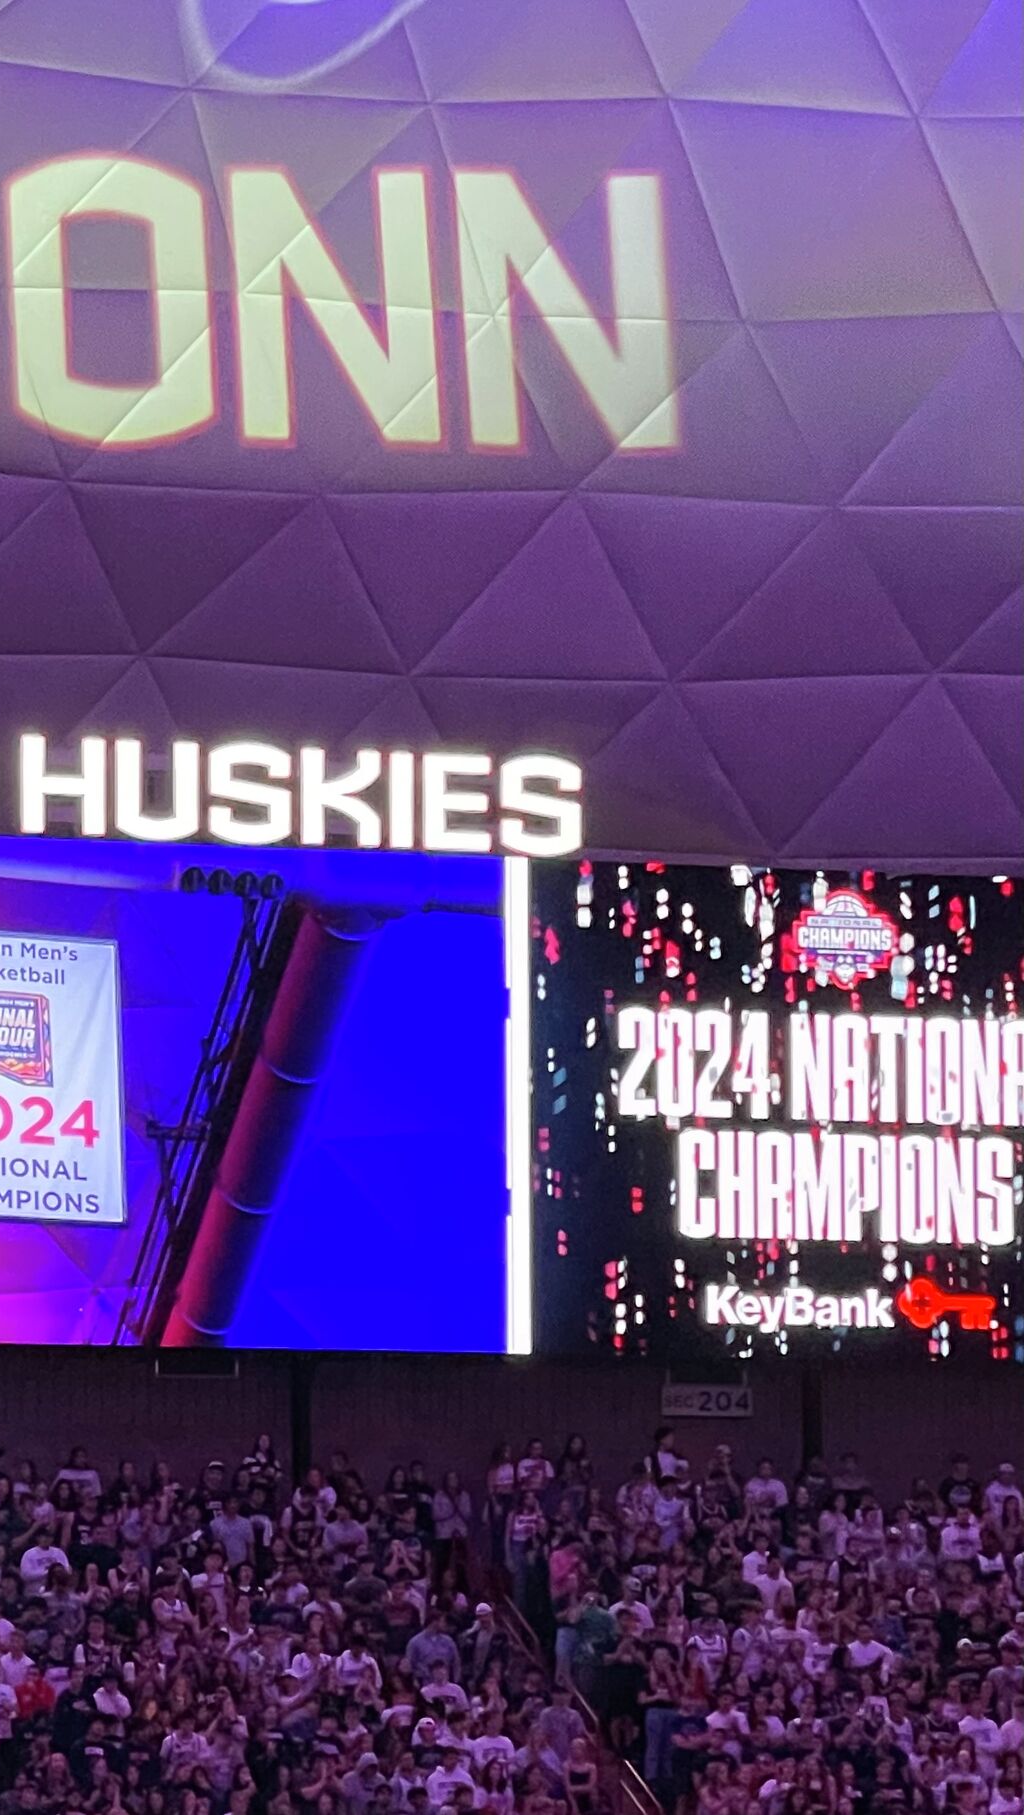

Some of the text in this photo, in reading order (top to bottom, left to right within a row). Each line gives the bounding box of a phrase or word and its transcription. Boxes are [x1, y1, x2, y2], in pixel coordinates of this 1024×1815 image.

[20, 733, 583, 857] HUSKIES
[20, 942, 79, 962] Men's
[797, 926, 893, 951] CHAMPIONS
[617, 1006, 771, 1120] 2024
[679, 1129, 1014, 1245] CHAMPIONS
[706, 1285, 894, 1334] KeyBank
[698, 1391, 750, 1412] 204
